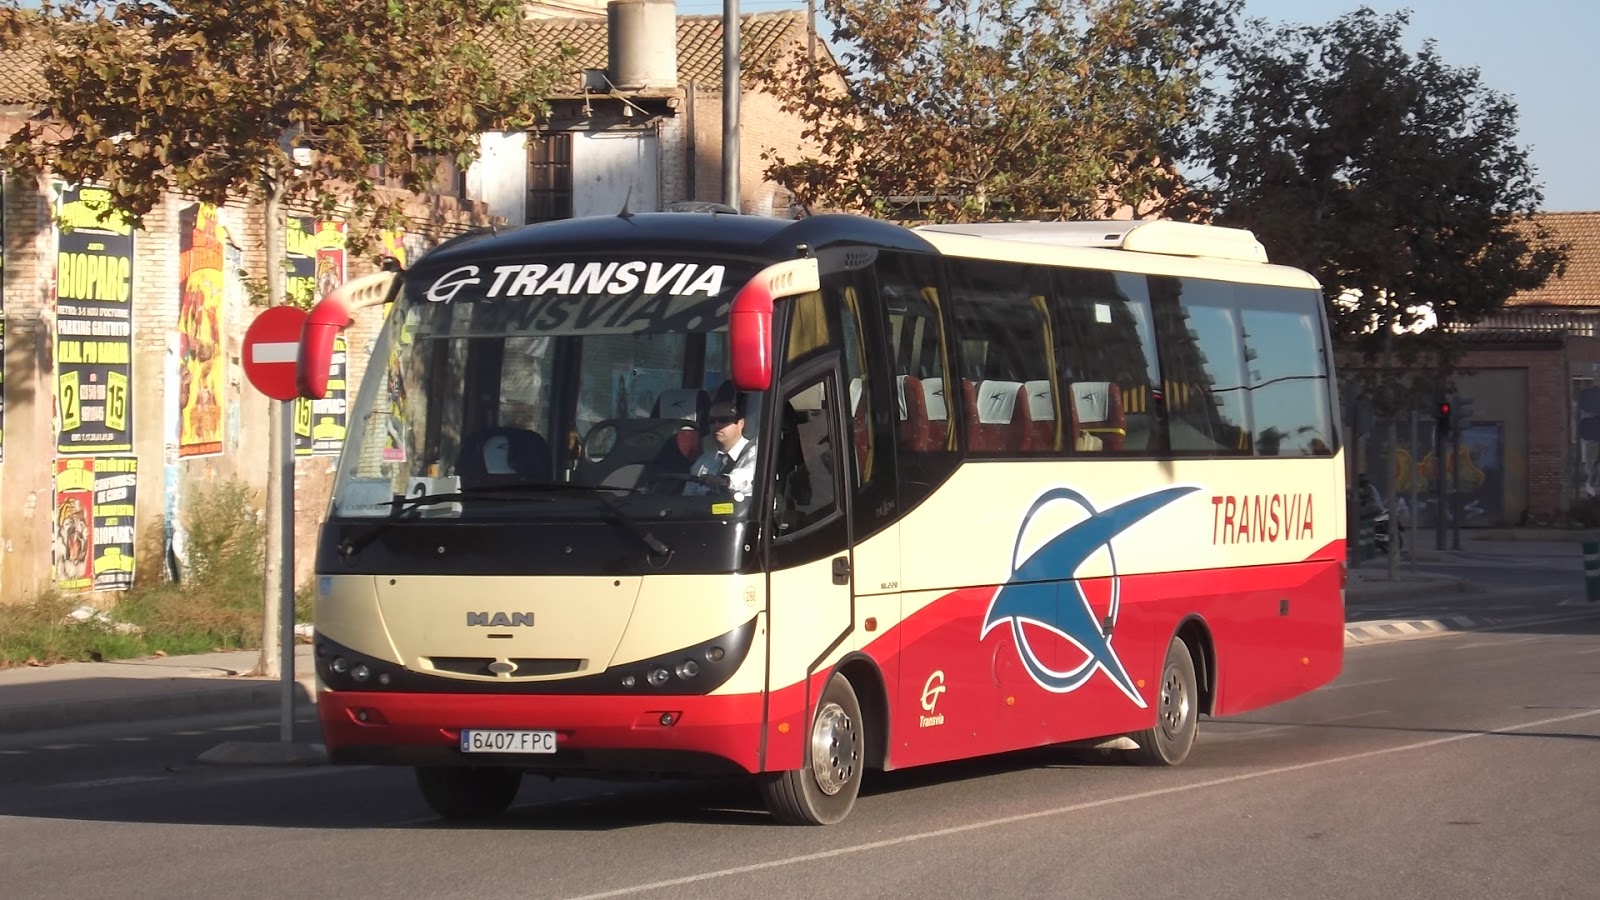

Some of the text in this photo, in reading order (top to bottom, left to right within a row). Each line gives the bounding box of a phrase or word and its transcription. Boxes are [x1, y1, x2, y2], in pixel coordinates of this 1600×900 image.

[58, 252, 130, 302] BIOPARC
[486, 261, 726, 299] TRANSVIA
[57, 320, 130, 337] PARKING GRATUITO
[64, 384, 74, 420] 2
[109, 384, 124, 420] 15
[297, 397, 310, 427] 15
[1211, 493, 1314, 545] TRANSVIA
[94, 526, 134, 545] BIOPARC
[466, 611, 535, 627] MAN
[919, 713, 945, 728] Transvia
[473, 732, 515, 749] 6407
[521, 733, 553, 750] FPC
